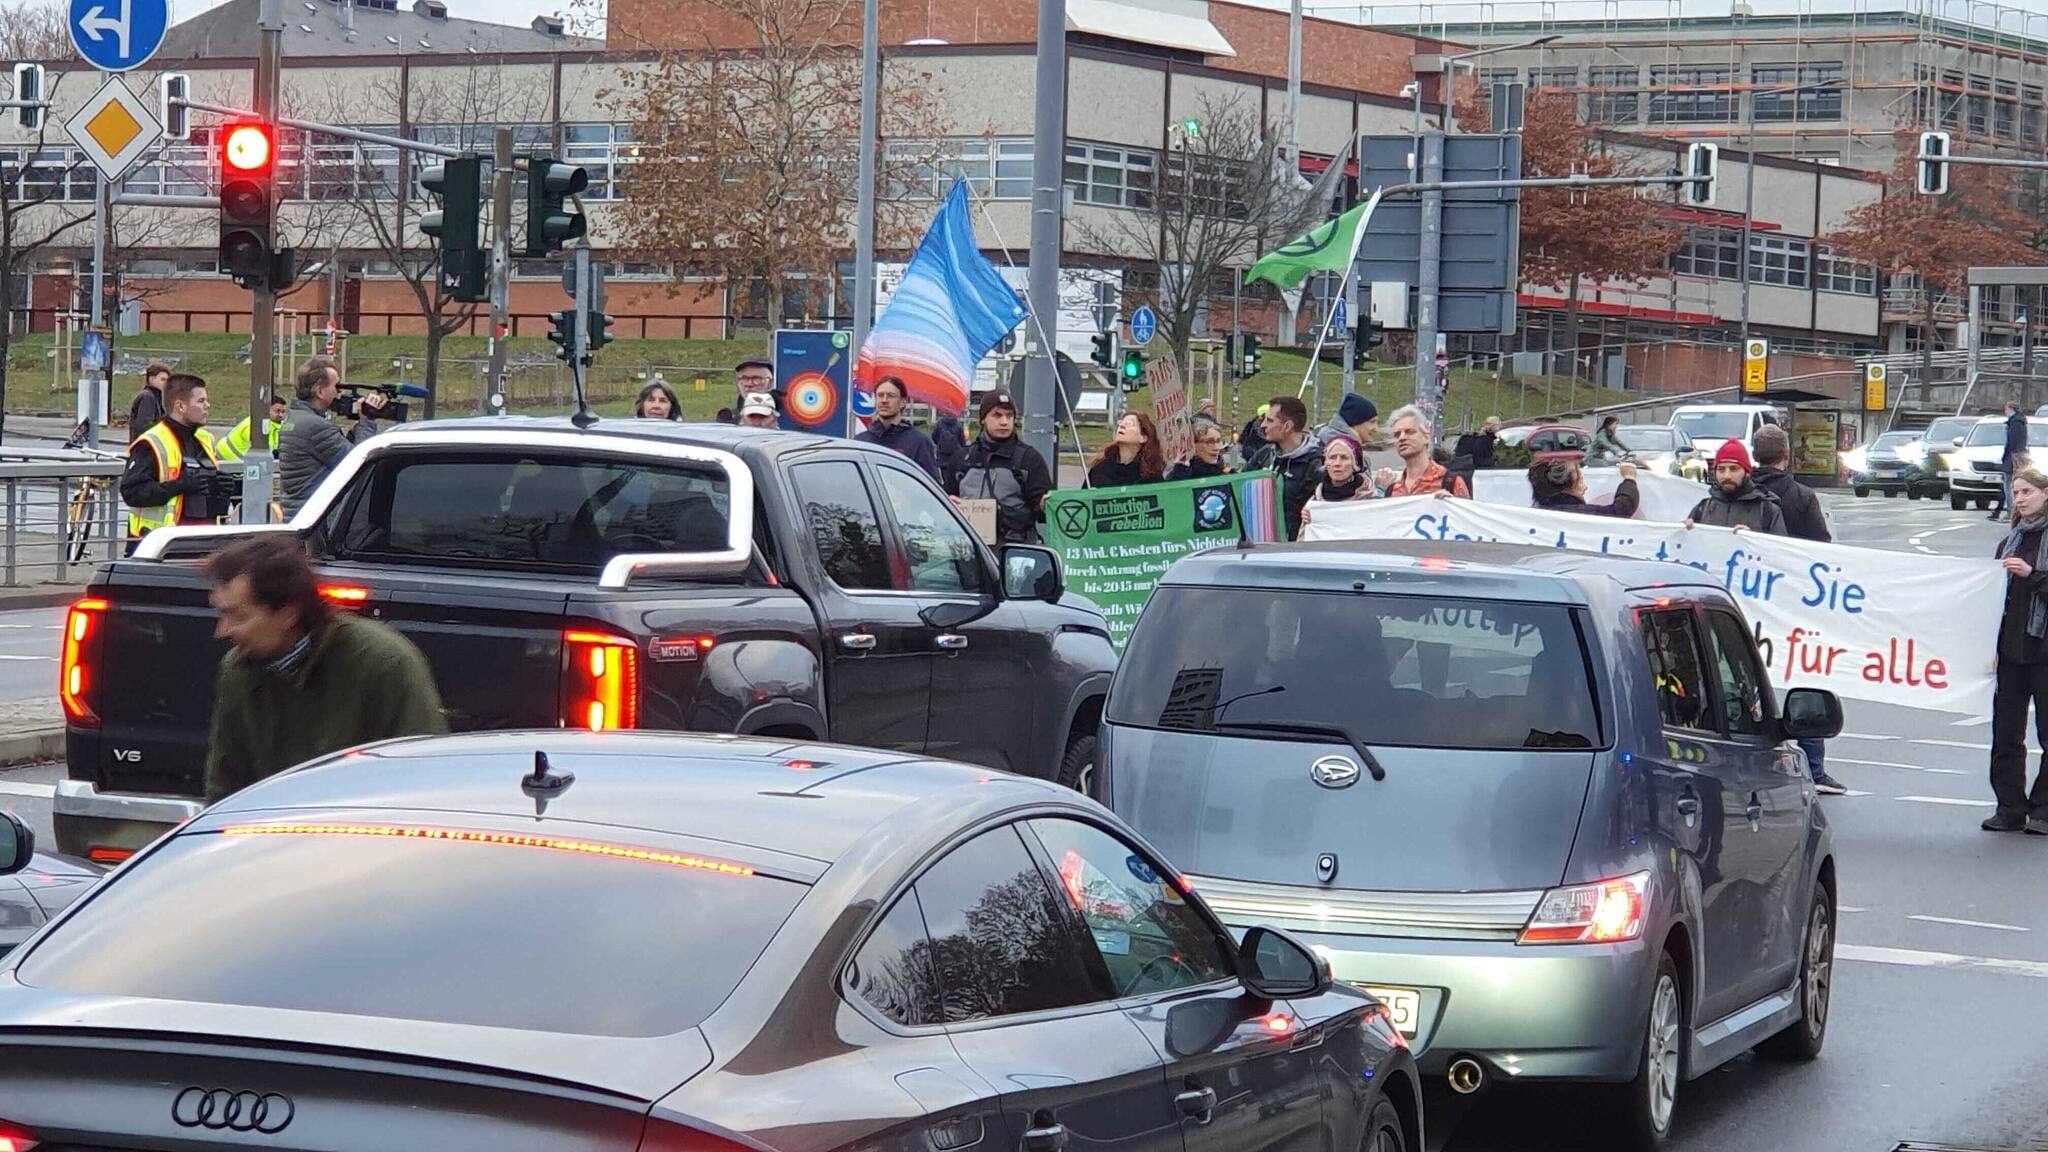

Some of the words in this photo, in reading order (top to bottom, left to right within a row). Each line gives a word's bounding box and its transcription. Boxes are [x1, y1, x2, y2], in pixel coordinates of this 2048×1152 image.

[1095, 497, 1150, 515] extinction
[1110, 511, 1163, 530] rebellion
[1084, 581, 1102, 593] bis
[1725, 549, 1785, 601] für
[1802, 561, 1866, 613] Sie
[1783, 627, 1848, 683] für
[1862, 637, 1949, 689] alle
[113, 749, 141, 761] V6
